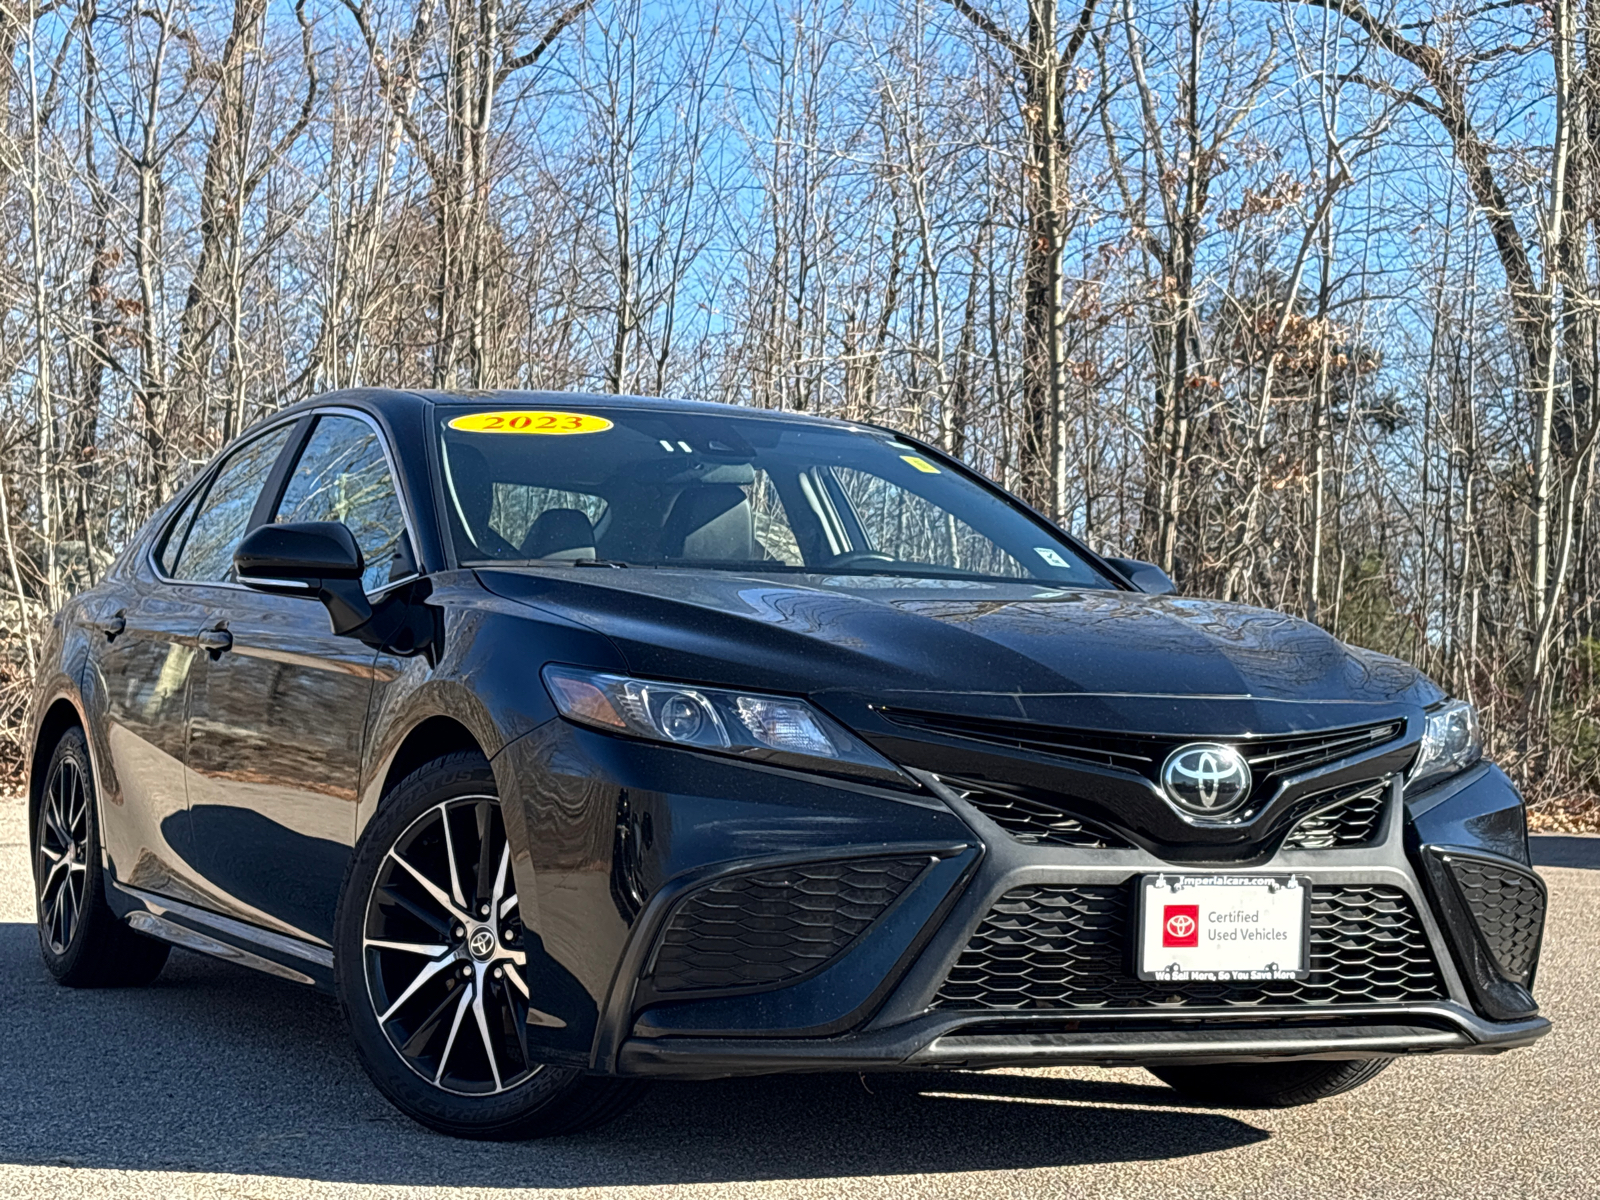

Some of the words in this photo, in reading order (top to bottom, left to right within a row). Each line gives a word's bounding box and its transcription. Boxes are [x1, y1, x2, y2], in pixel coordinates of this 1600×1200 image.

[482, 416, 583, 430] 2023
[1180, 875, 1276, 887] Imperialcars.com
[1208, 910, 1259, 923] Certified
[1208, 927, 1237, 941] Used
[1240, 927, 1288, 941] Vehicles
[1154, 971, 1170, 981] We
[1171, 971, 1189, 981] Sell
[1191, 971, 1216, 982] More,
[1218, 971, 1230, 981] So
[1231, 970, 1249, 981] You
[1250, 970, 1272, 980] Save
[1273, 970, 1296, 980] More
